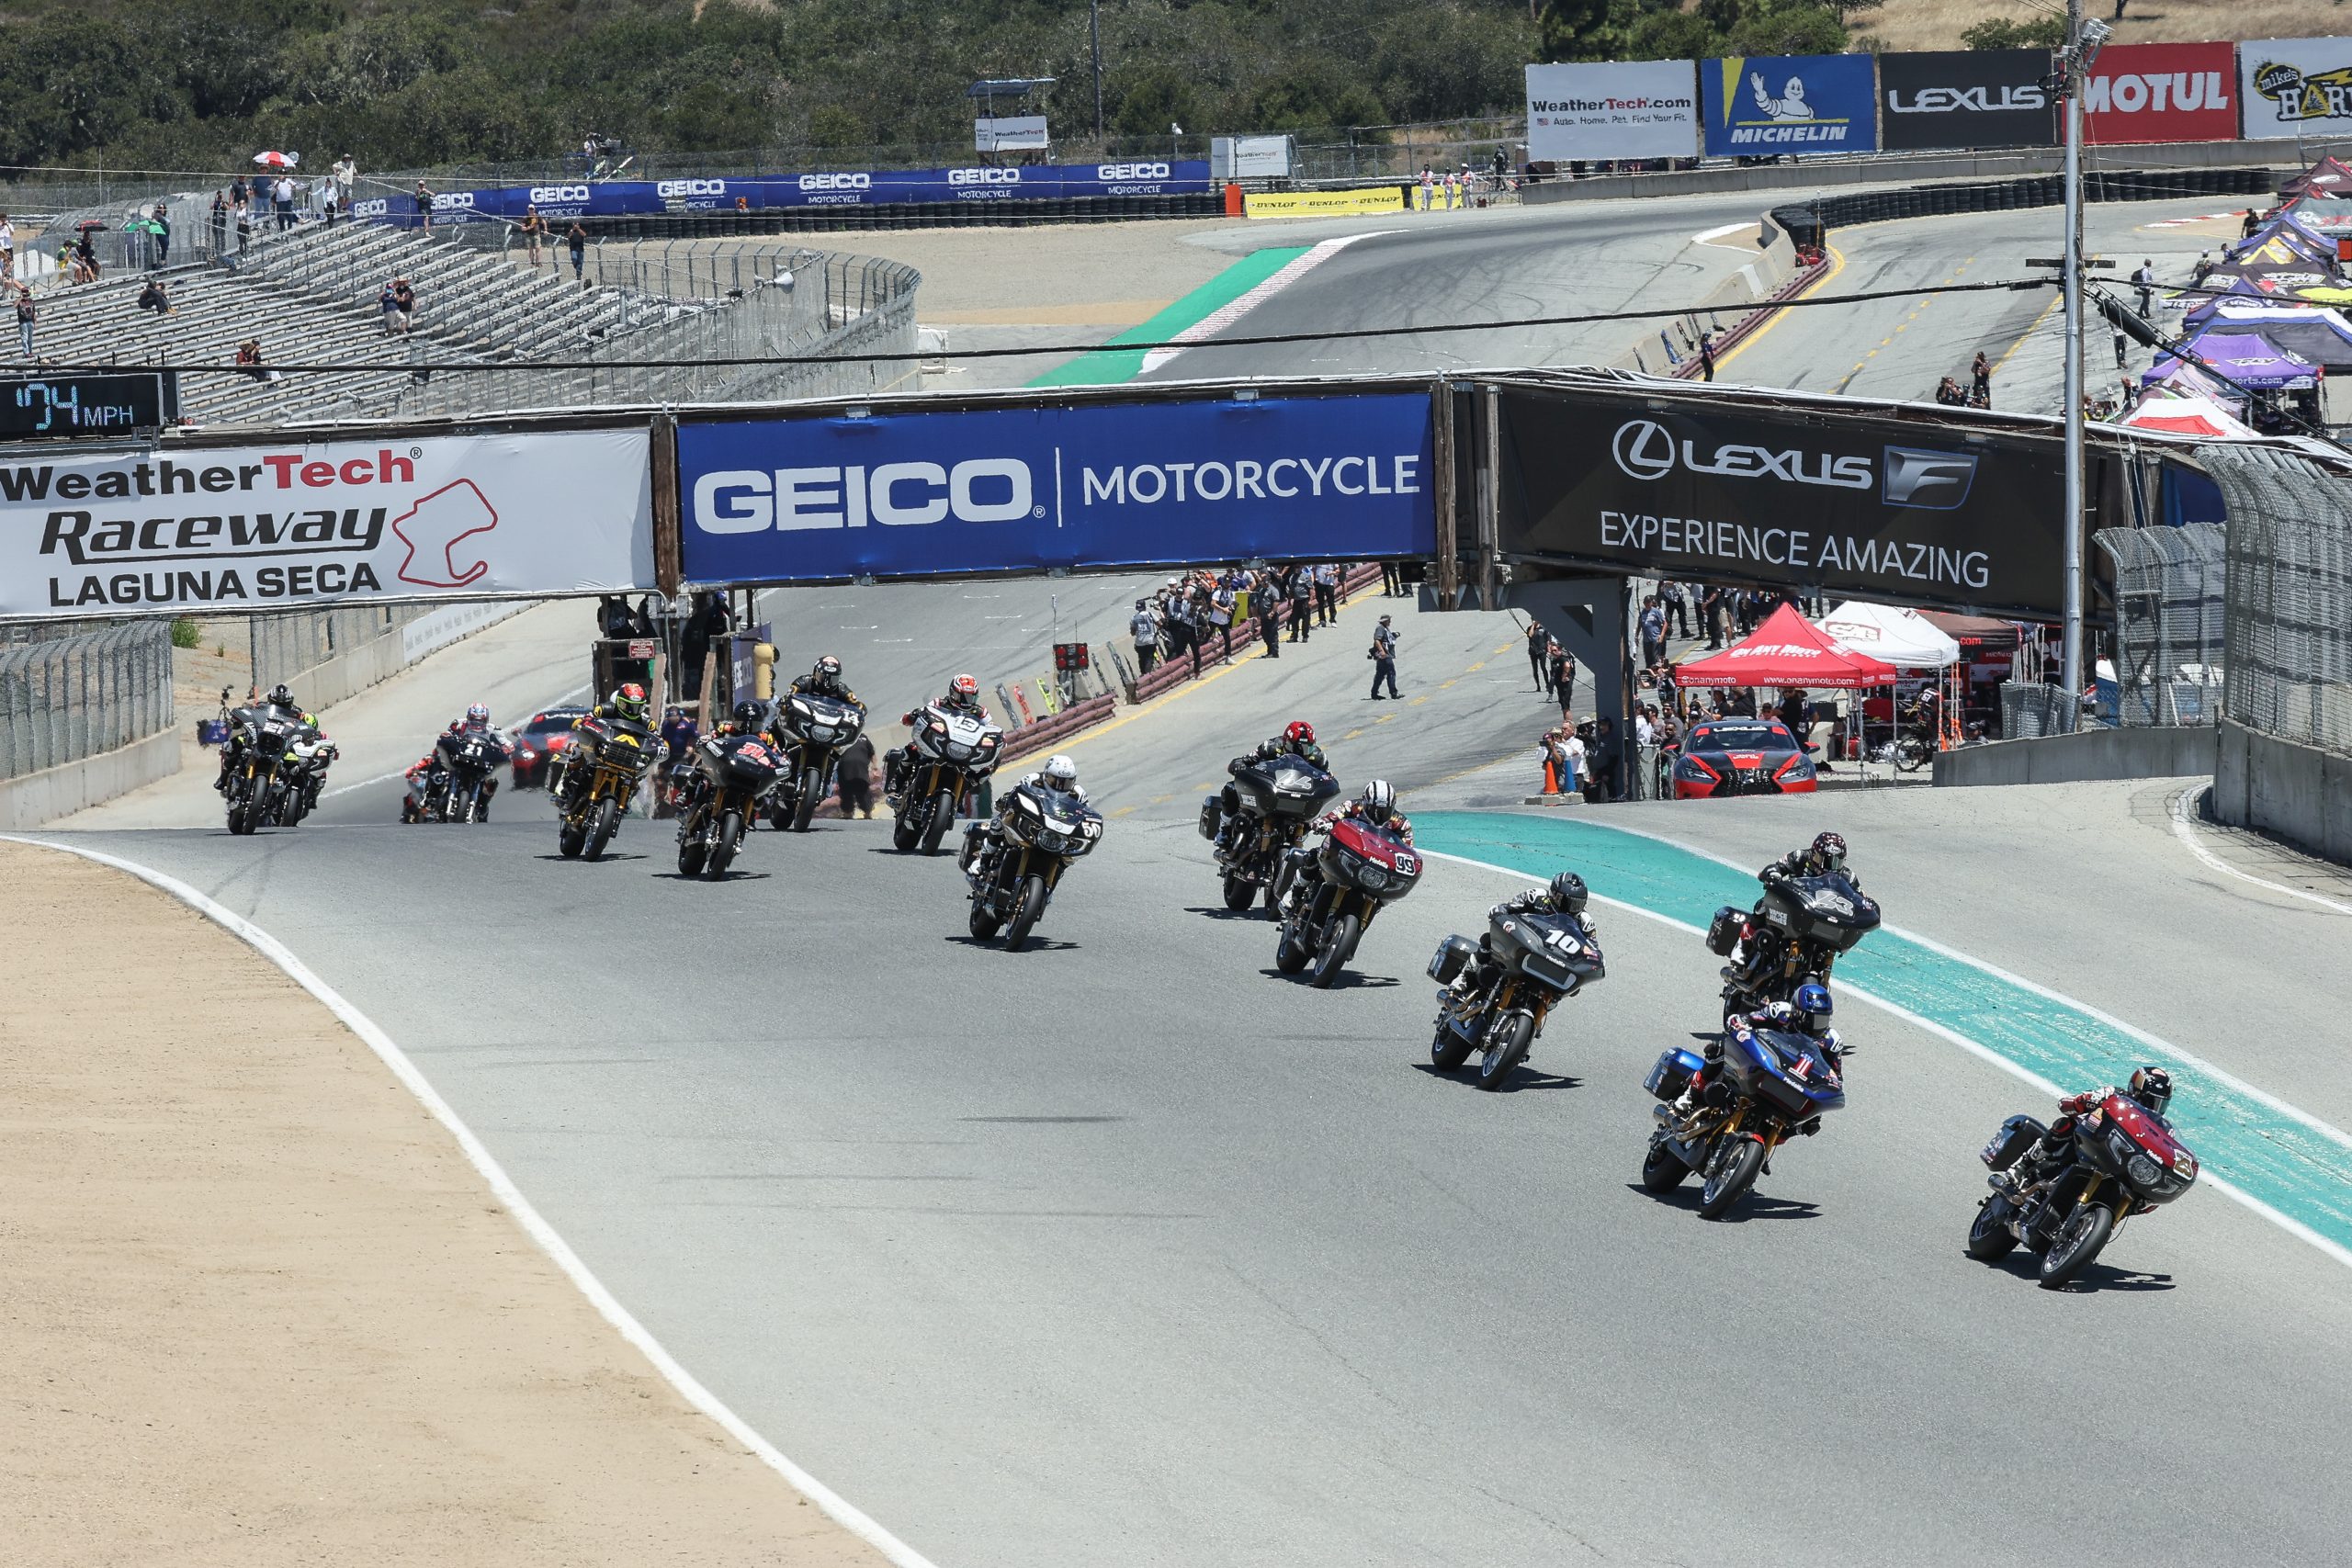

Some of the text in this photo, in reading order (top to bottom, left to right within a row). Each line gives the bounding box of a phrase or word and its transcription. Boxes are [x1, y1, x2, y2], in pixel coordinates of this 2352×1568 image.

[2260, 69, 2299, 90] mike's
[1889, 85, 2047, 113] LEXUS
[2085, 72, 2229, 113] MOTUL
[1632, 114, 1651, 123] Find
[1653, 113, 1671, 123] Your
[1731, 125, 1848, 143] MICHELIN
[948, 167, 1021, 184] GEICO
[1098, 163, 1170, 180] GEICO
[657, 178, 726, 197] GEICO
[798, 173, 870, 190] GEICO
[1108, 185, 1161, 195] MOTORCYCLE
[529, 185, 590, 203] GEICO
[808, 194, 861, 204] MOTORCYCLE
[957, 189, 1012, 199] MOTORCYCLE
[1359, 196, 1400, 204] DUNLOP
[354, 198, 387, 218] GEICO
[1256, 201, 1296, 209] DUNLOP
[84, 405, 133, 427] MPH
[1683, 439, 1872, 490] LEXUS
[1083, 454, 1420, 505] MOTORCYCLE
[40, 507, 388, 565] Raceway
[1600, 511, 1989, 588] EXPERIENCE AMAZING
[49, 562, 382, 607] LAGUNA SECA
[842, 710, 860, 728] 14
[955, 716, 979, 733] 13
[1081, 821, 1102, 838] 50
[1396, 855, 1416, 874] 99
[1544, 929, 1581, 954] 10
